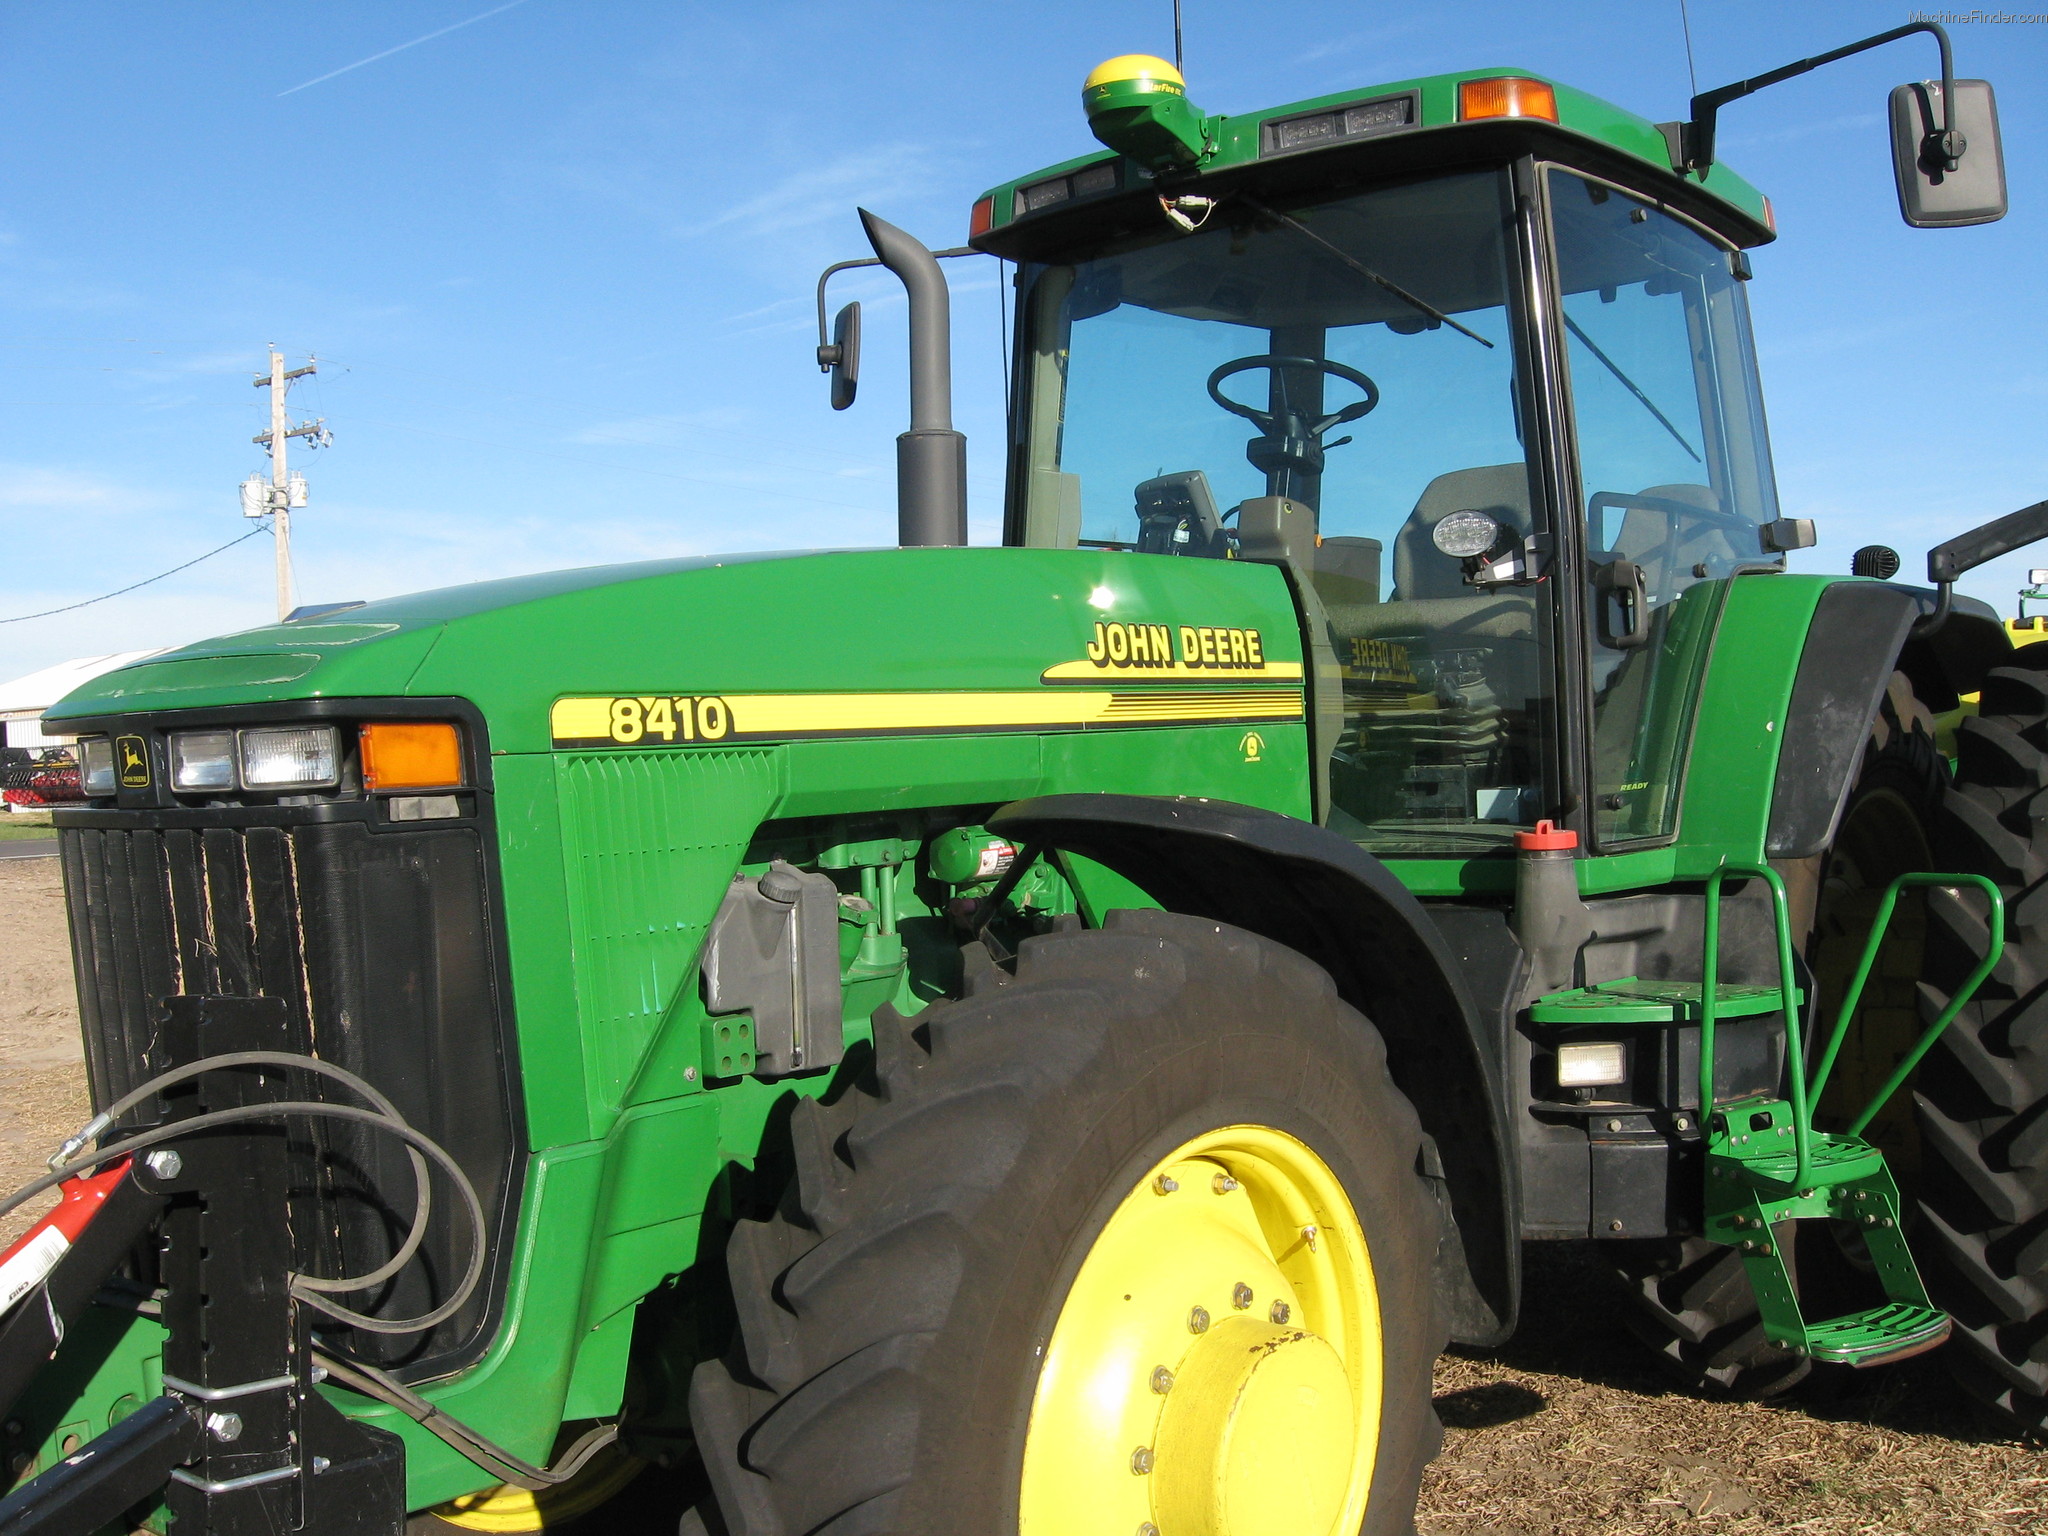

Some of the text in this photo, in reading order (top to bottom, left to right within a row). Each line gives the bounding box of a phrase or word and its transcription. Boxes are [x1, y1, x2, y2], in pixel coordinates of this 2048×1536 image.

[1087, 622, 1264, 669] JOHN DEERE
[609, 696, 728, 743] 8410
[1620, 781, 1649, 791] READY
